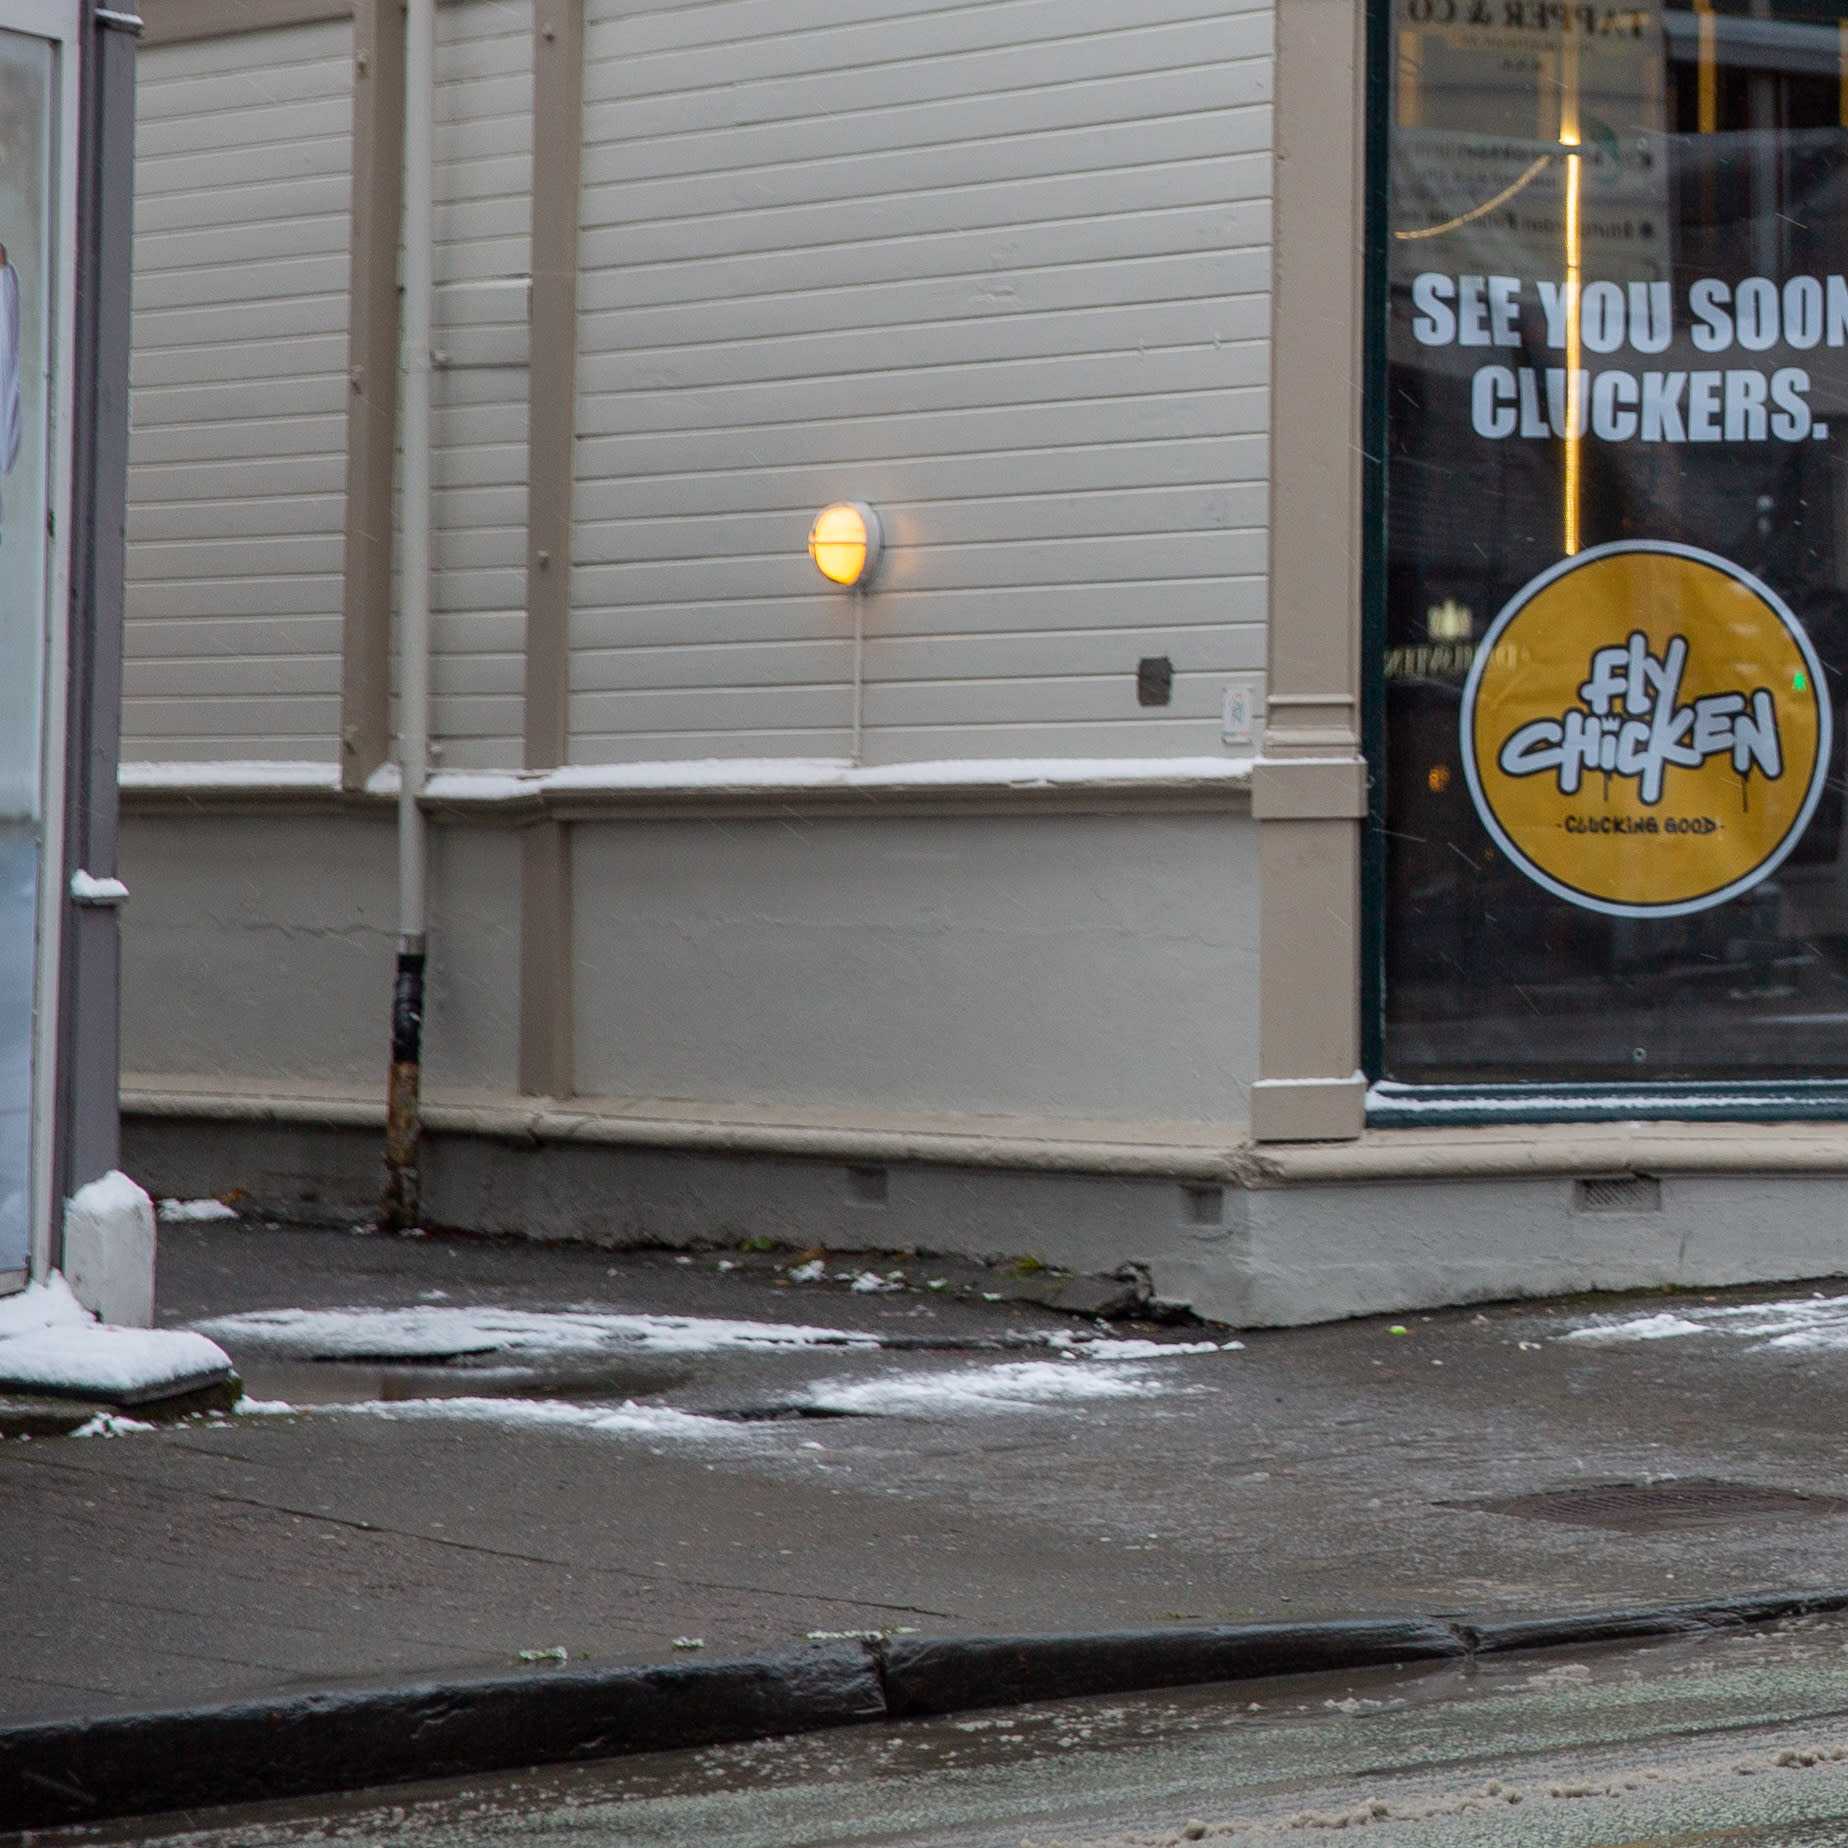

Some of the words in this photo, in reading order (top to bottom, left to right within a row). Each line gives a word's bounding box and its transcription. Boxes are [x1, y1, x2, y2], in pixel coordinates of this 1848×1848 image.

[1411, 271, 1521, 348] SEE
[1535, 280, 1672, 354] YOU
[1471, 364, 1829, 444] CLUCKERS.
